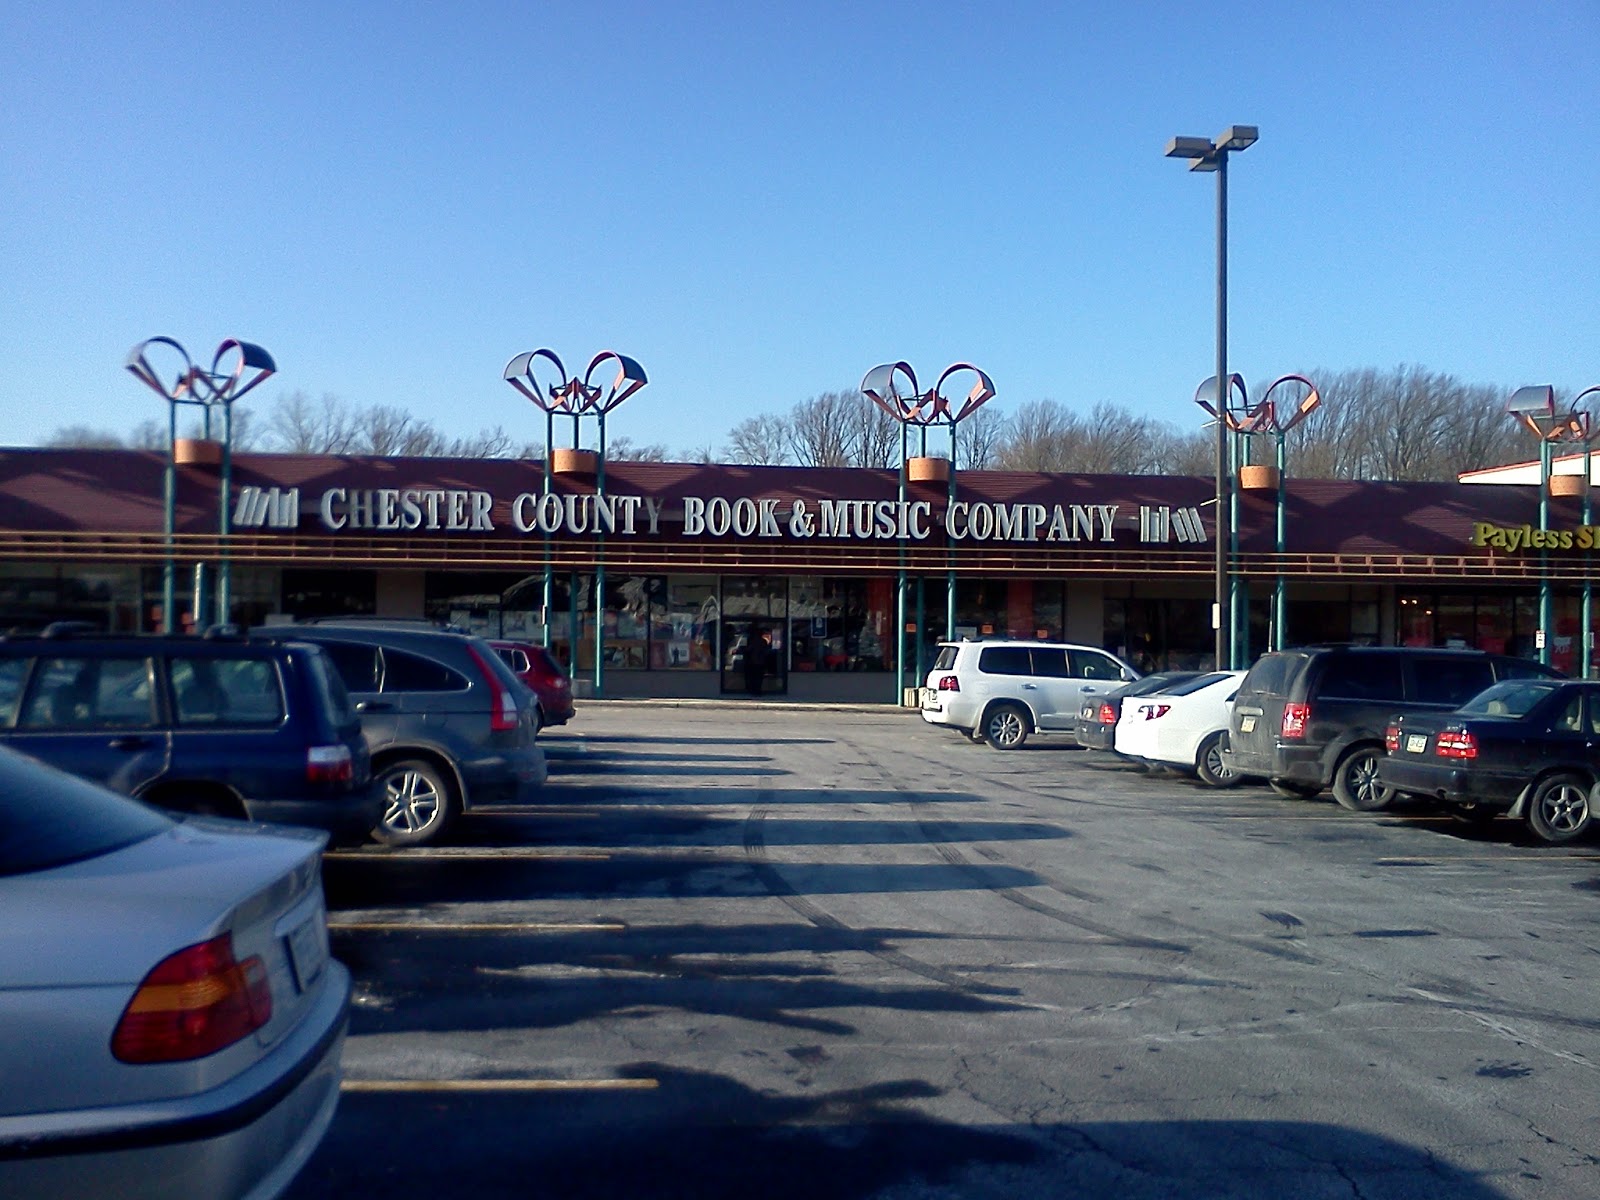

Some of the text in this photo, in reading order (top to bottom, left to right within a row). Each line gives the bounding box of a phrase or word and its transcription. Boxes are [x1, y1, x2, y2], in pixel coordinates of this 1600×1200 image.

[321, 487, 1119, 542] CHESTER COUNTY BOOK & MUSIC COMPANY
[1474, 522, 1573, 552] Payless
